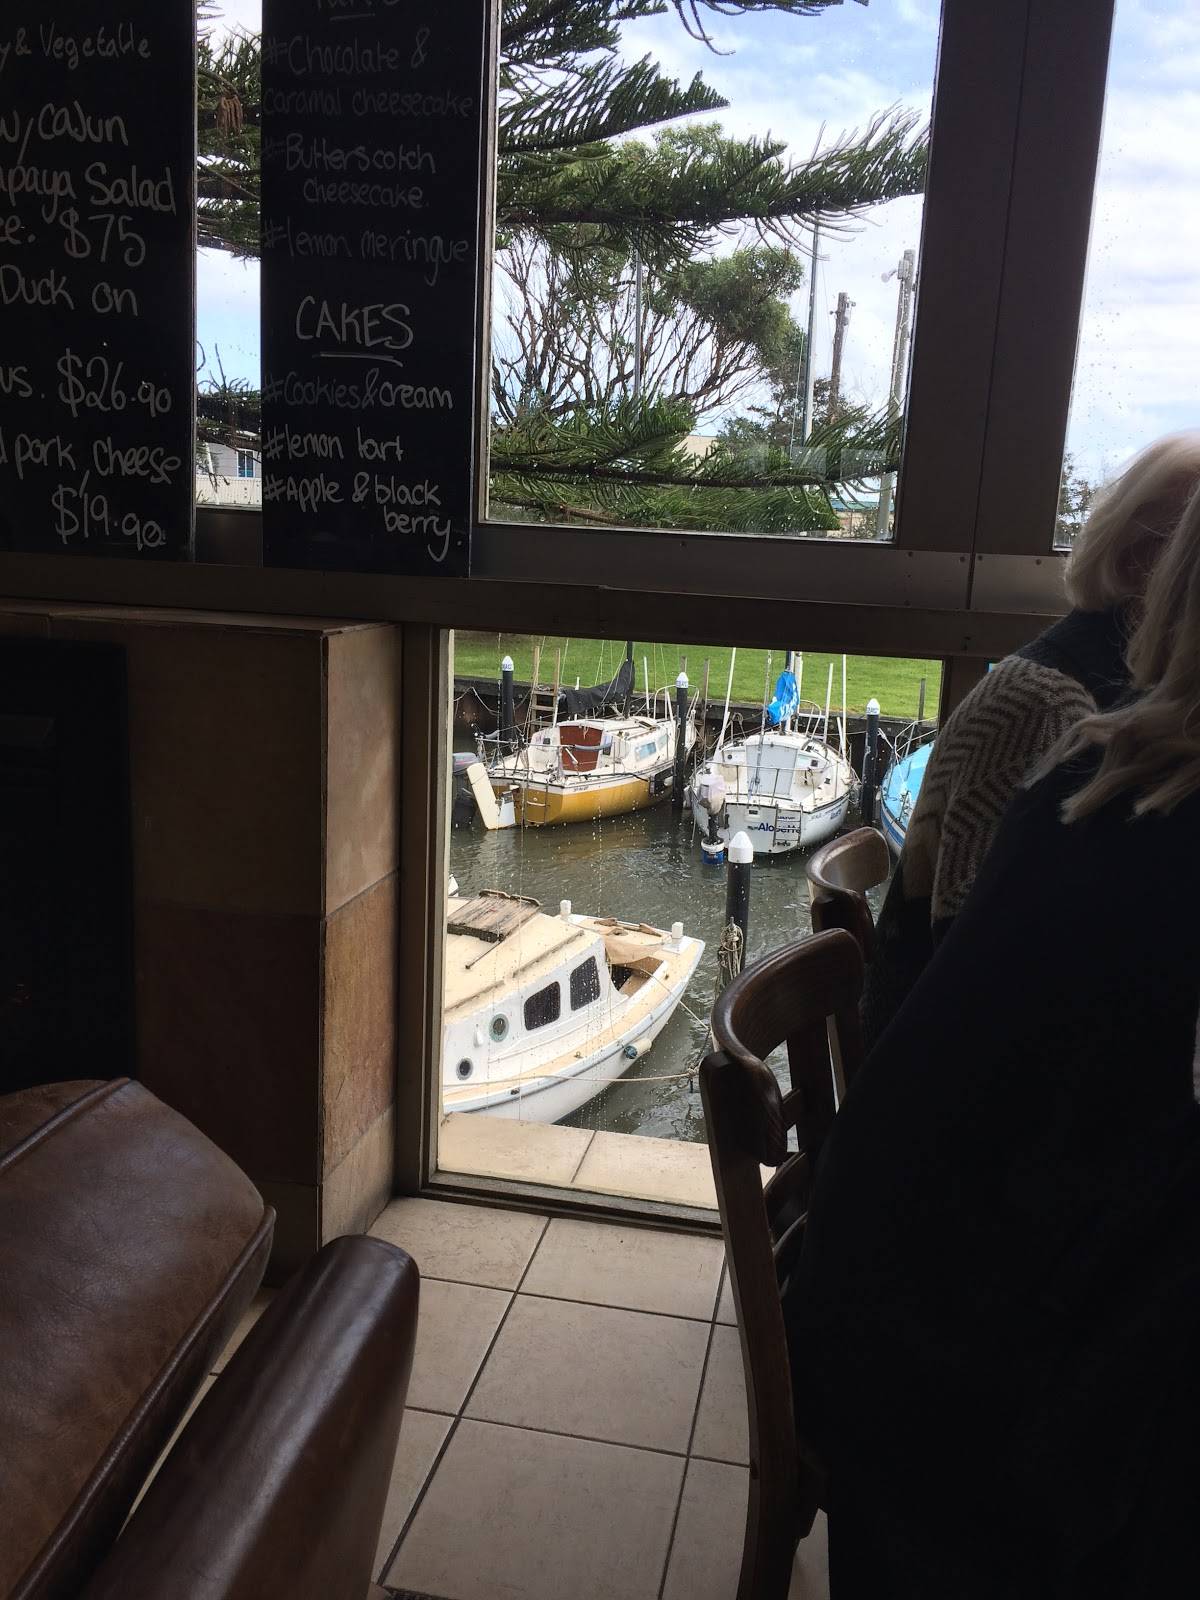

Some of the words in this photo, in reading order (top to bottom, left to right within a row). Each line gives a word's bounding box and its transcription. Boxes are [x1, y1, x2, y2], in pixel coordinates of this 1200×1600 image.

[15, 27, 33, 56] &
[410, 27, 431, 69] &
[59, 206, 146, 267] $75
[0, 264, 75, 310] Duck
[295, 295, 414, 350] CAKES
[56, 347, 172, 418] $26.90
[351, 471, 370, 504] &
[374, 473, 442, 506] black
